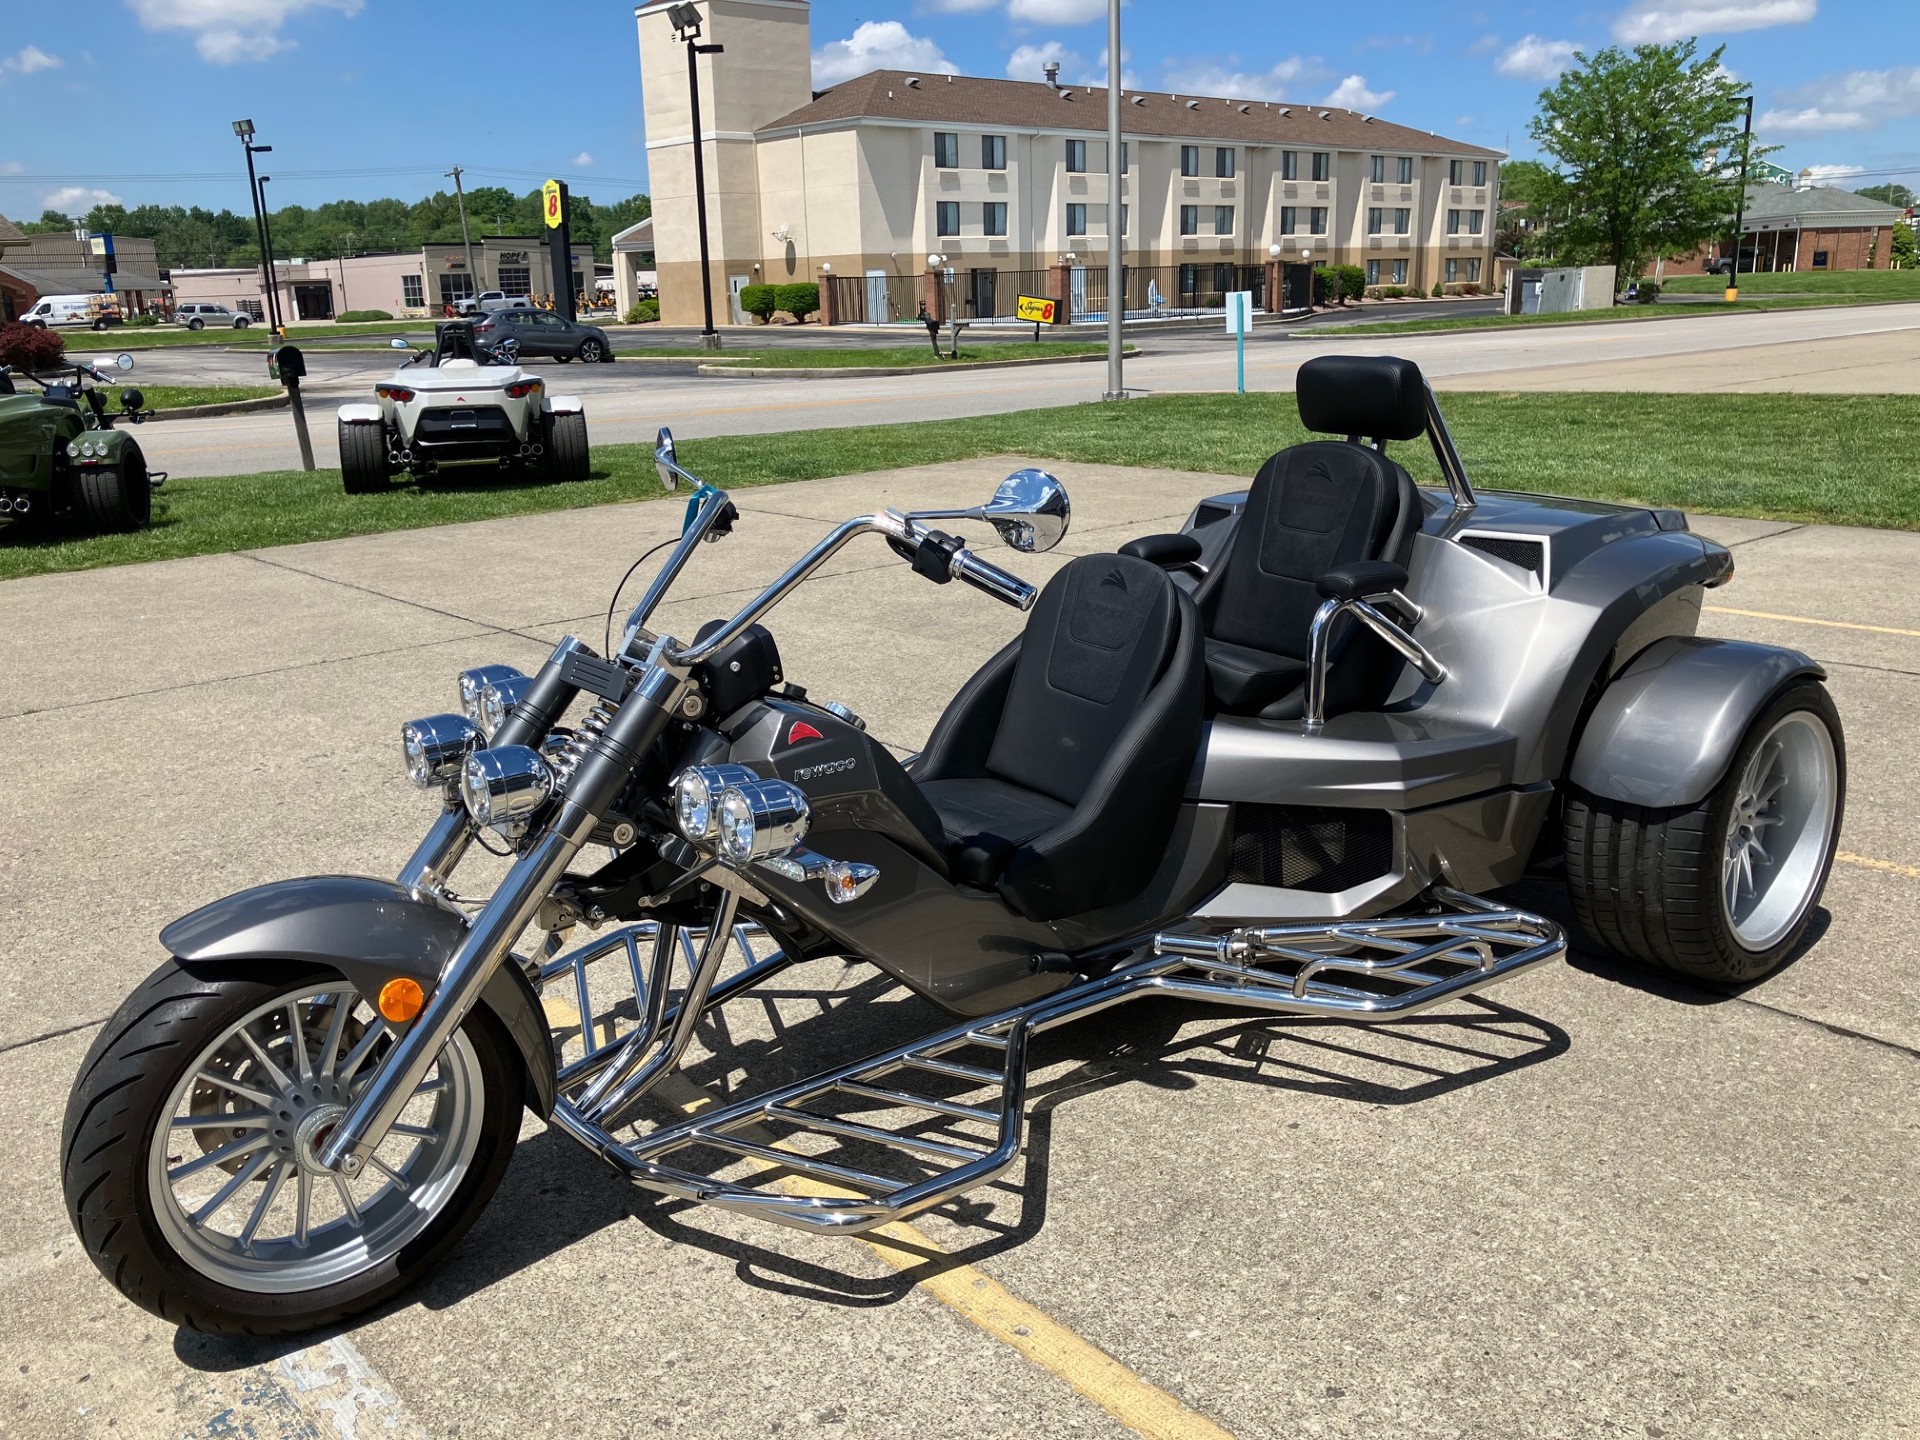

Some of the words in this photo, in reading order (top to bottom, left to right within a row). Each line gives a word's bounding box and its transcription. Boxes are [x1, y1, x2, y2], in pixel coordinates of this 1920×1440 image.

[549, 194, 558, 218] 8
[500, 252, 522, 260] HOPF
[1025, 301, 1044, 316] Super
[1041, 303, 1054, 320] 8
[794, 757, 857, 783] rewaco
